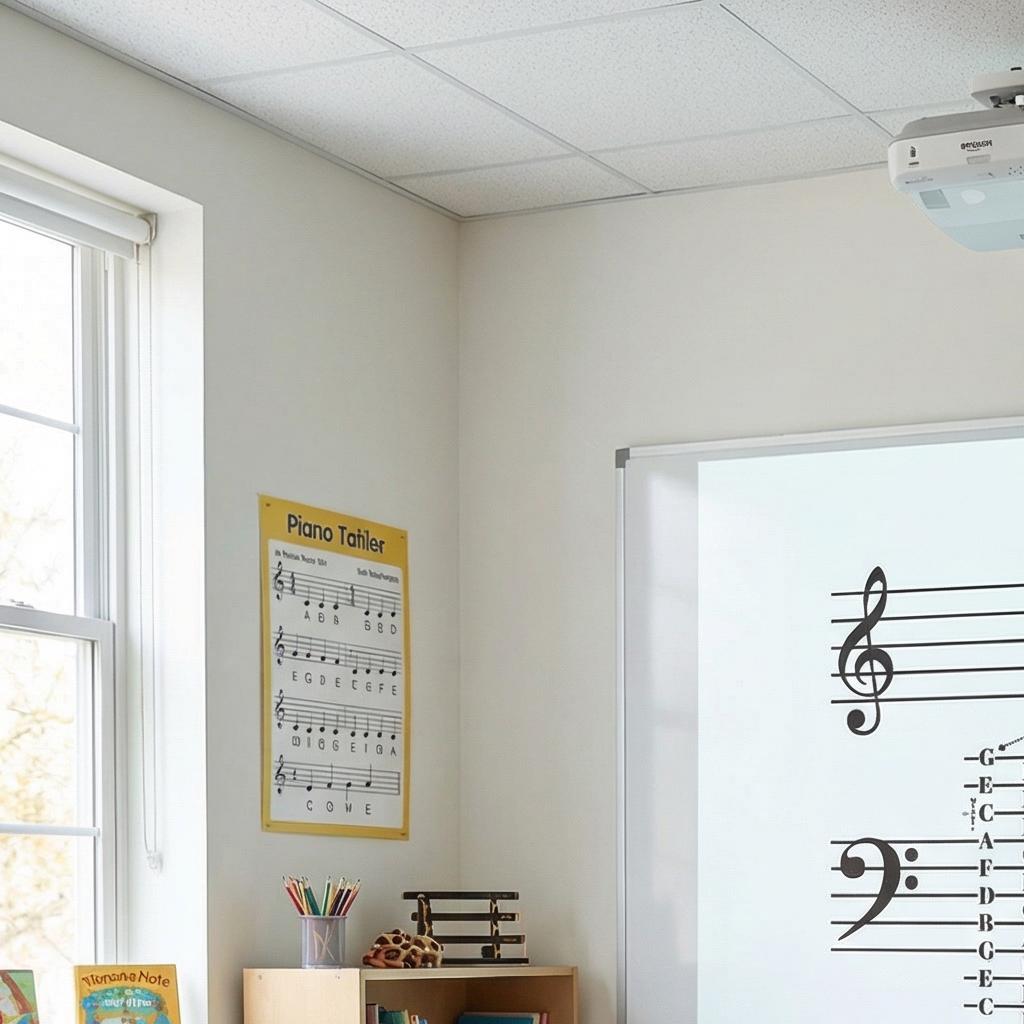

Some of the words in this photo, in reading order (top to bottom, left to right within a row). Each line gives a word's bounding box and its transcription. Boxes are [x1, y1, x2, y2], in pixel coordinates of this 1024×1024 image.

[288, 514, 333, 542] Piano
[304, 610, 311, 621] A
[390, 623, 397, 635] D
[292, 670, 298, 682] E
[304, 672, 313, 684] G
[335, 677, 341, 688] E
[378, 683, 385, 694] F
[391, 684, 397, 696] E
[350, 741, 356, 753] E
[977, 748, 994, 765] G
[979, 777, 992, 793] E
[365, 803, 371, 816] E
[978, 804, 993, 822] C
[978, 832, 993, 849] A
[979, 859, 992, 876] F
[979, 887, 996, 904] D
[979, 914, 993, 931] B
[978, 941, 993, 960] G
[138, 970, 170, 988] Note
[979, 970, 992, 987] E
[978, 998, 993, 1015] C
